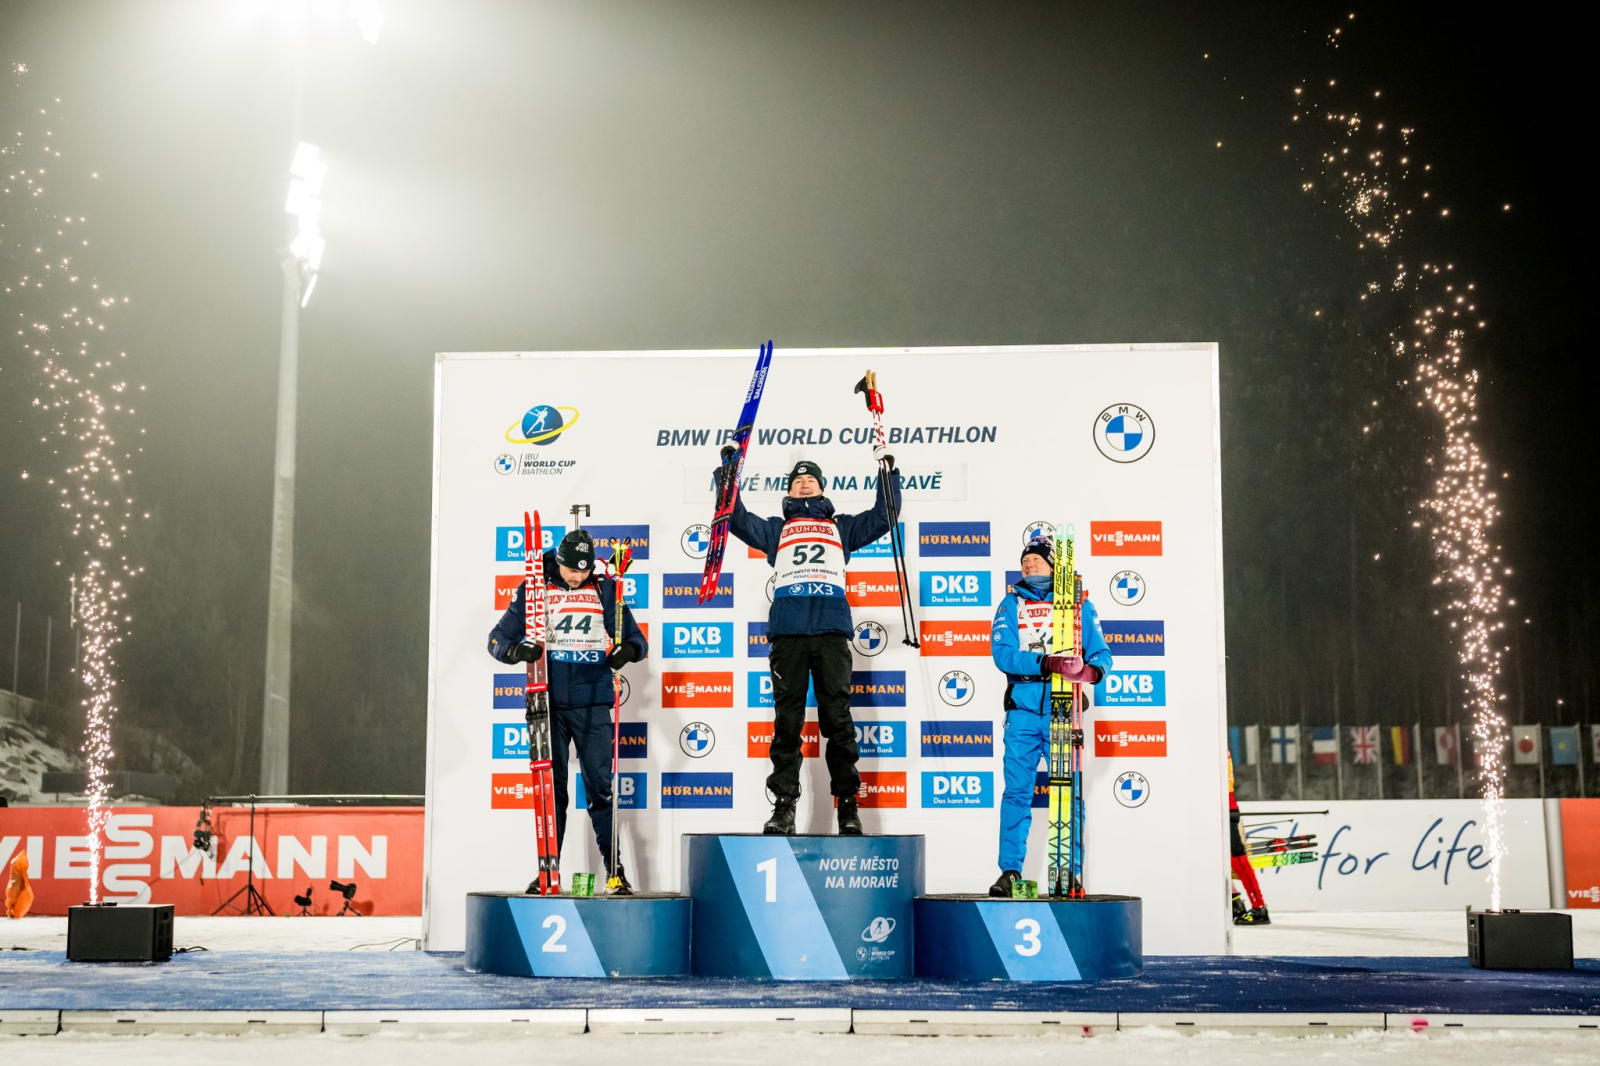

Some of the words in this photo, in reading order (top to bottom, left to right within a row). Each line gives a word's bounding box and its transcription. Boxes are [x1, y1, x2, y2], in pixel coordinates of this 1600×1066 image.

[1101, 406, 1147, 423] BMW
[656, 429, 710, 446] BMW
[758, 428, 836, 445] WORLD
[889, 426, 997, 443] BIATHLON
[832, 476, 858, 490] NA
[507, 530, 554, 549] DB
[781, 525, 834, 538] BAUHAUS
[920, 535, 990, 545] HÖRMANN
[1093, 530, 1161, 546] VIESSMANN
[792, 544, 826, 566] 52
[1055, 539, 1064, 596] FISCHER
[1065, 539, 1075, 596] FISCHER
[808, 583, 834, 595] iX3
[846, 582, 904, 597] IESSMANN
[931, 575, 979, 594] DKB
[534, 548, 546, 642] MADSHUS
[555, 615, 592, 635] 44
[674, 626, 721, 646] DKB
[922, 630, 990, 647] VIESSMANN
[1104, 633, 1163, 644] ÖRMANN
[573, 651, 600, 662] iX3
[665, 682, 731, 698] VIESSMANN
[1105, 674, 1154, 694] DKB
[1106, 695, 1118, 703] Das
[922, 734, 992, 744] HÖRMANN
[1097, 731, 1165, 747] VIESSMANN
[494, 783, 534, 799] VIESSM
[663, 785, 732, 796] HÖRMANN
[933, 775, 982, 795] DKB
[819, 855, 858, 871] NOVÉ
[860, 855, 899, 871] MĚSTO
[1318, 825, 1390, 890] for
[756, 857, 777, 902] 1
[825, 876, 845, 888] NA
[849, 873, 899, 888] MORAVĚ
[541, 915, 567, 953] 2
[1014, 919, 1042, 957] 3
